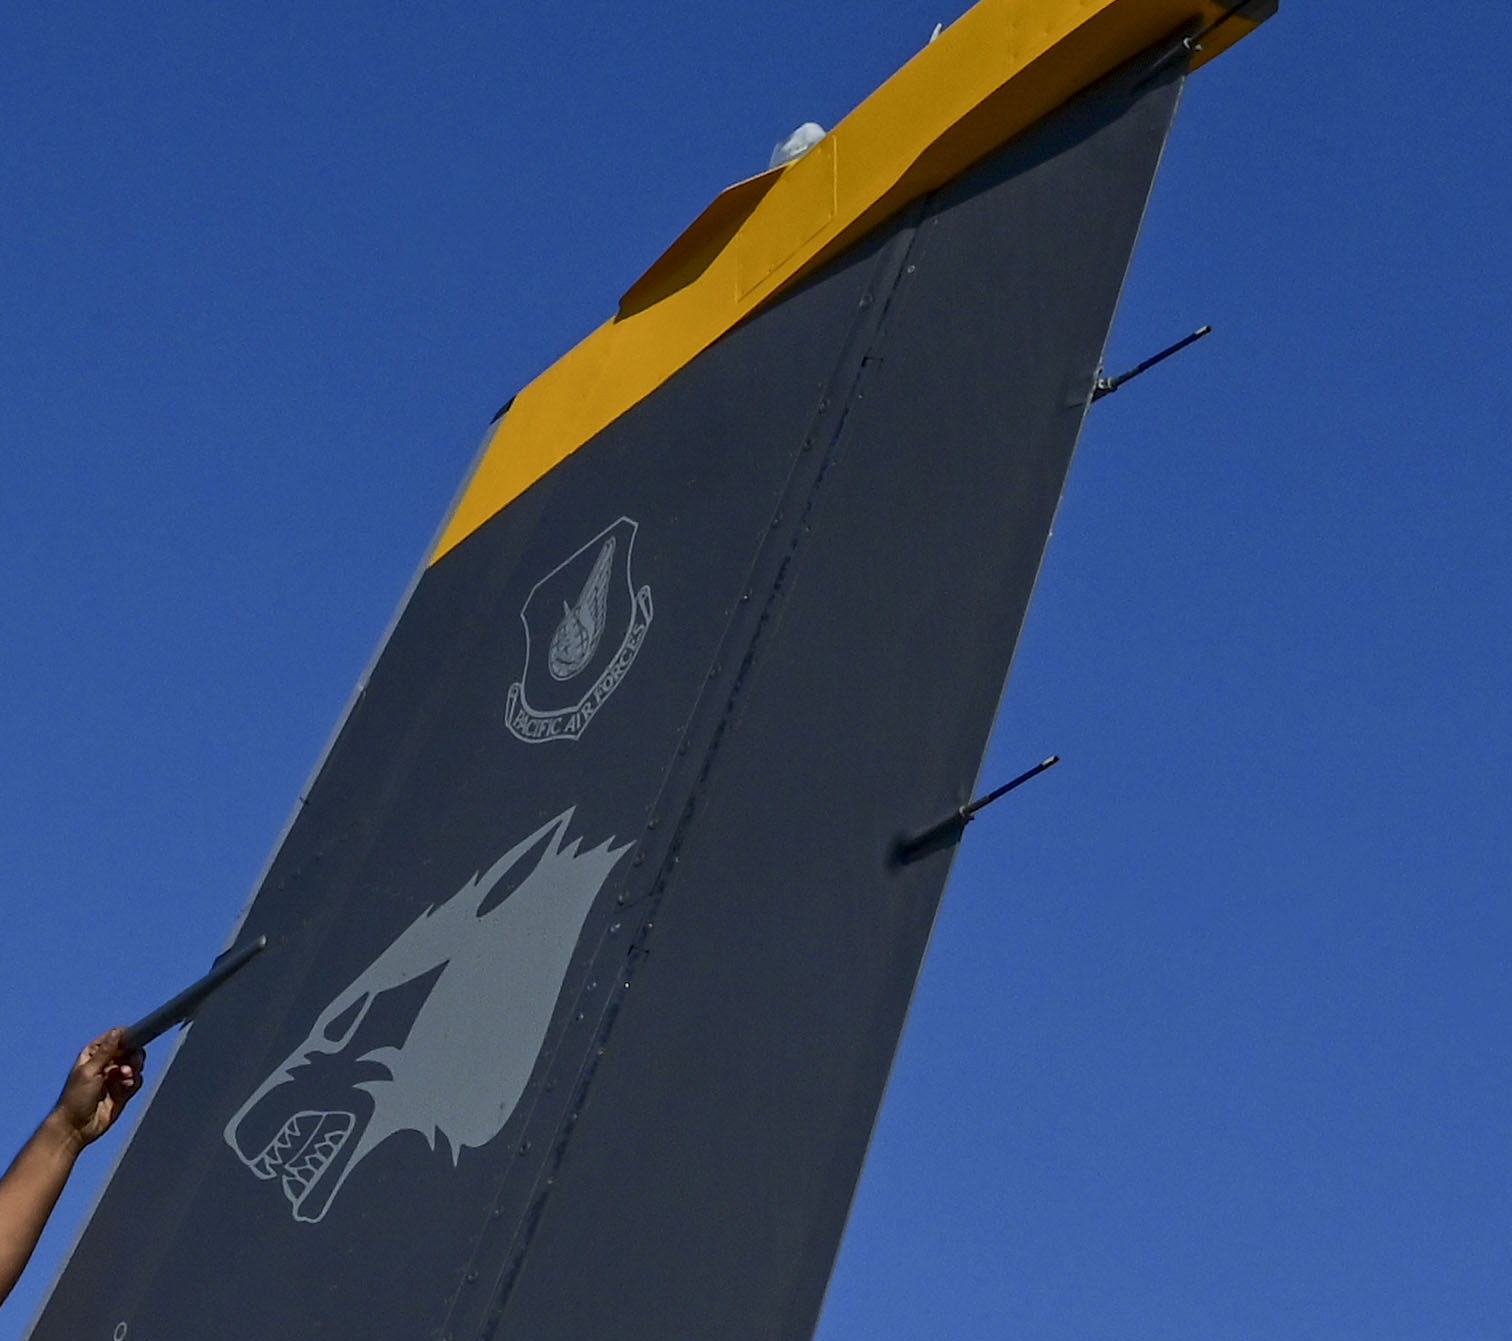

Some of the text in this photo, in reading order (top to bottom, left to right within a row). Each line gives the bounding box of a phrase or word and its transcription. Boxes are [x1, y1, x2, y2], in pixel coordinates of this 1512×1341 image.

[512, 623, 645, 738] PACIFIC AIR FORCES
